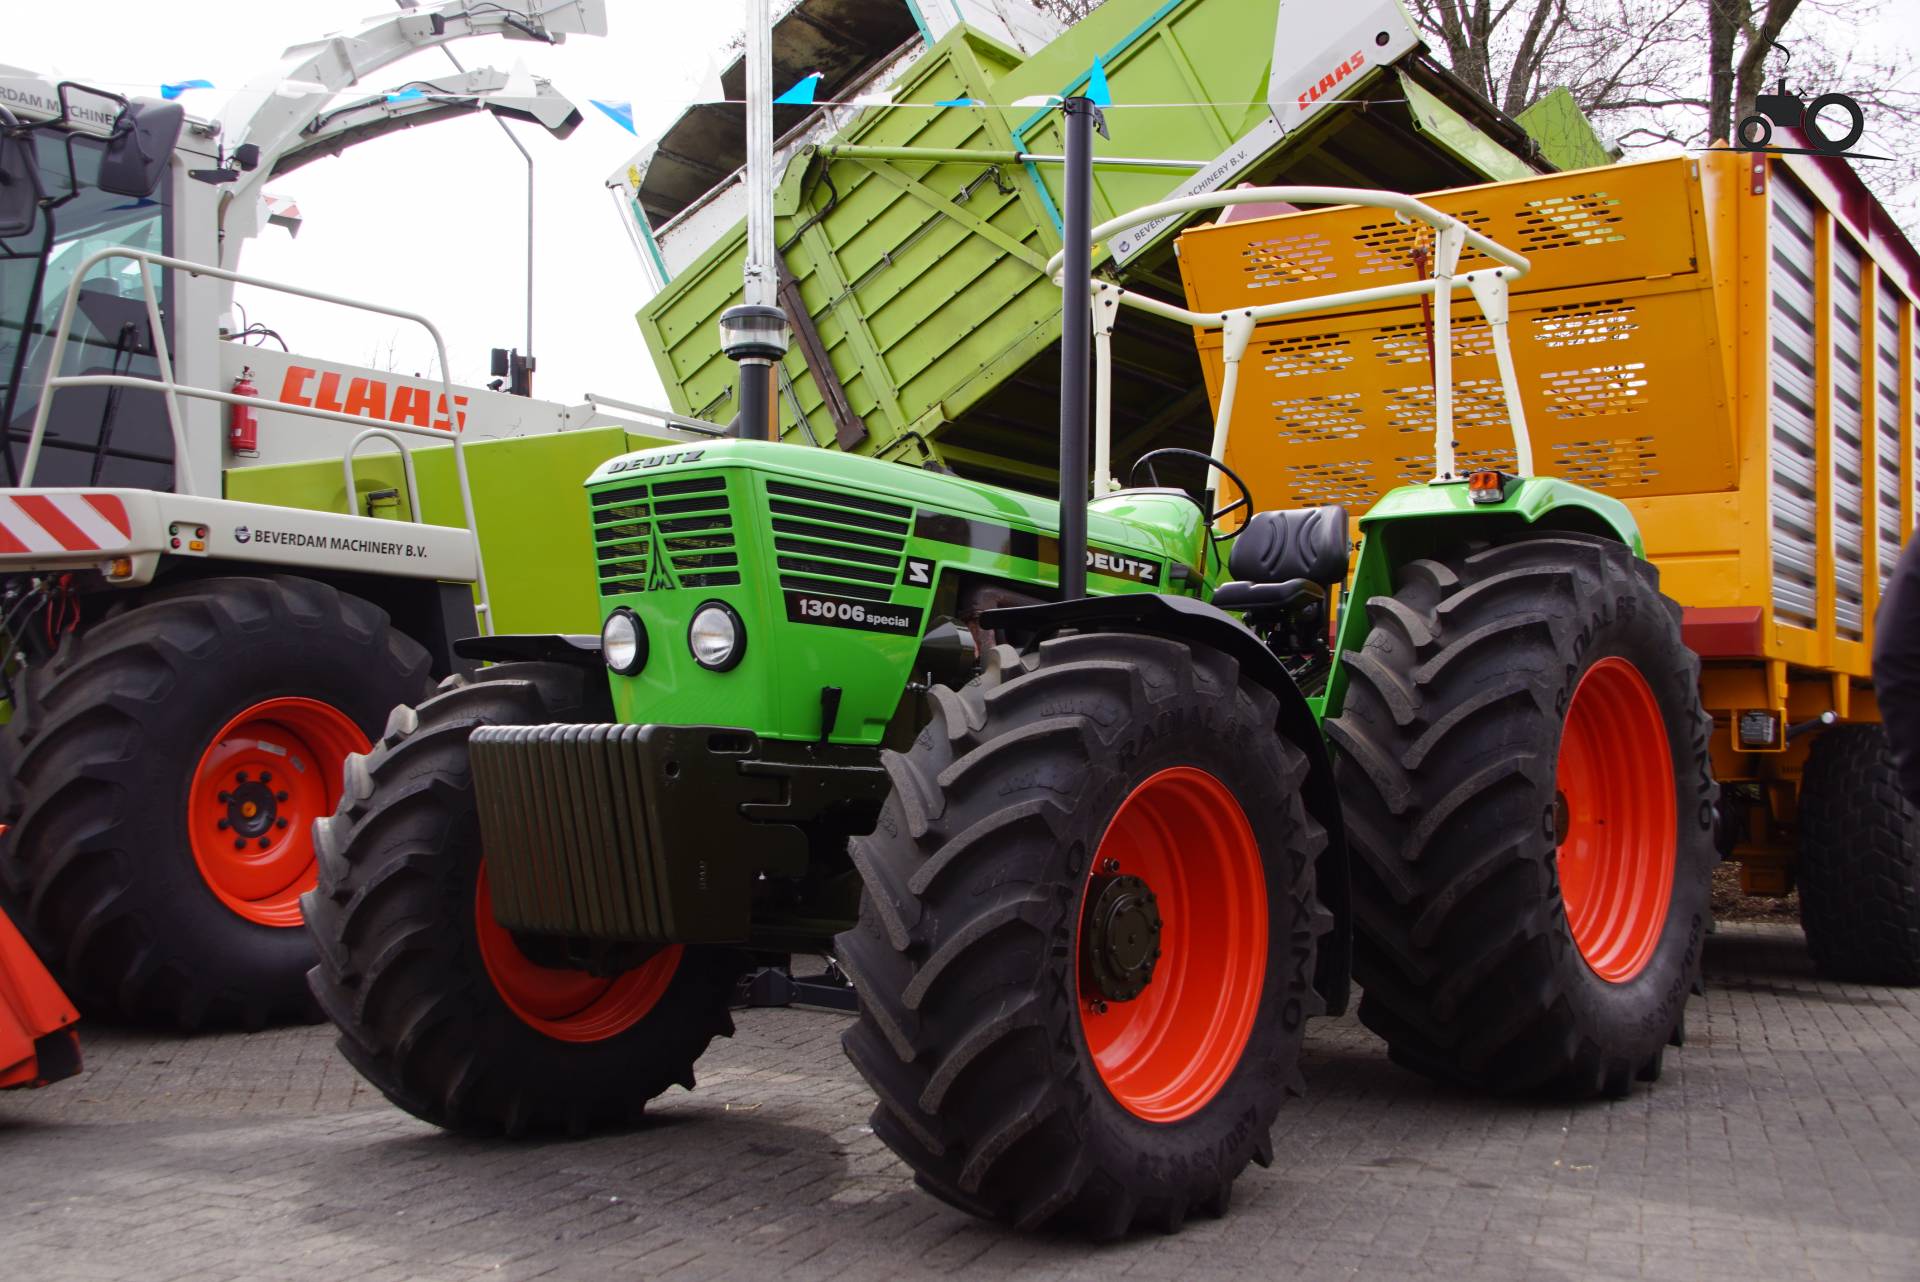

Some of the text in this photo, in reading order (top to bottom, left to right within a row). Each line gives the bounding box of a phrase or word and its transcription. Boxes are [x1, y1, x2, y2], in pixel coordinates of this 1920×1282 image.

[1297, 49, 1365, 111] CLAAS
[46, 99, 118, 126] MCHINE
[1184, 163, 1229, 198] ACHINERY
[1230, 150, 1248, 167] B.V.
[280, 365, 469, 433] CLAAS
[608, 450, 705, 474] DEUTZ
[254, 529, 428, 558] BEVERDAM MACHINERY B.V.
[866, 613, 909, 628] special
